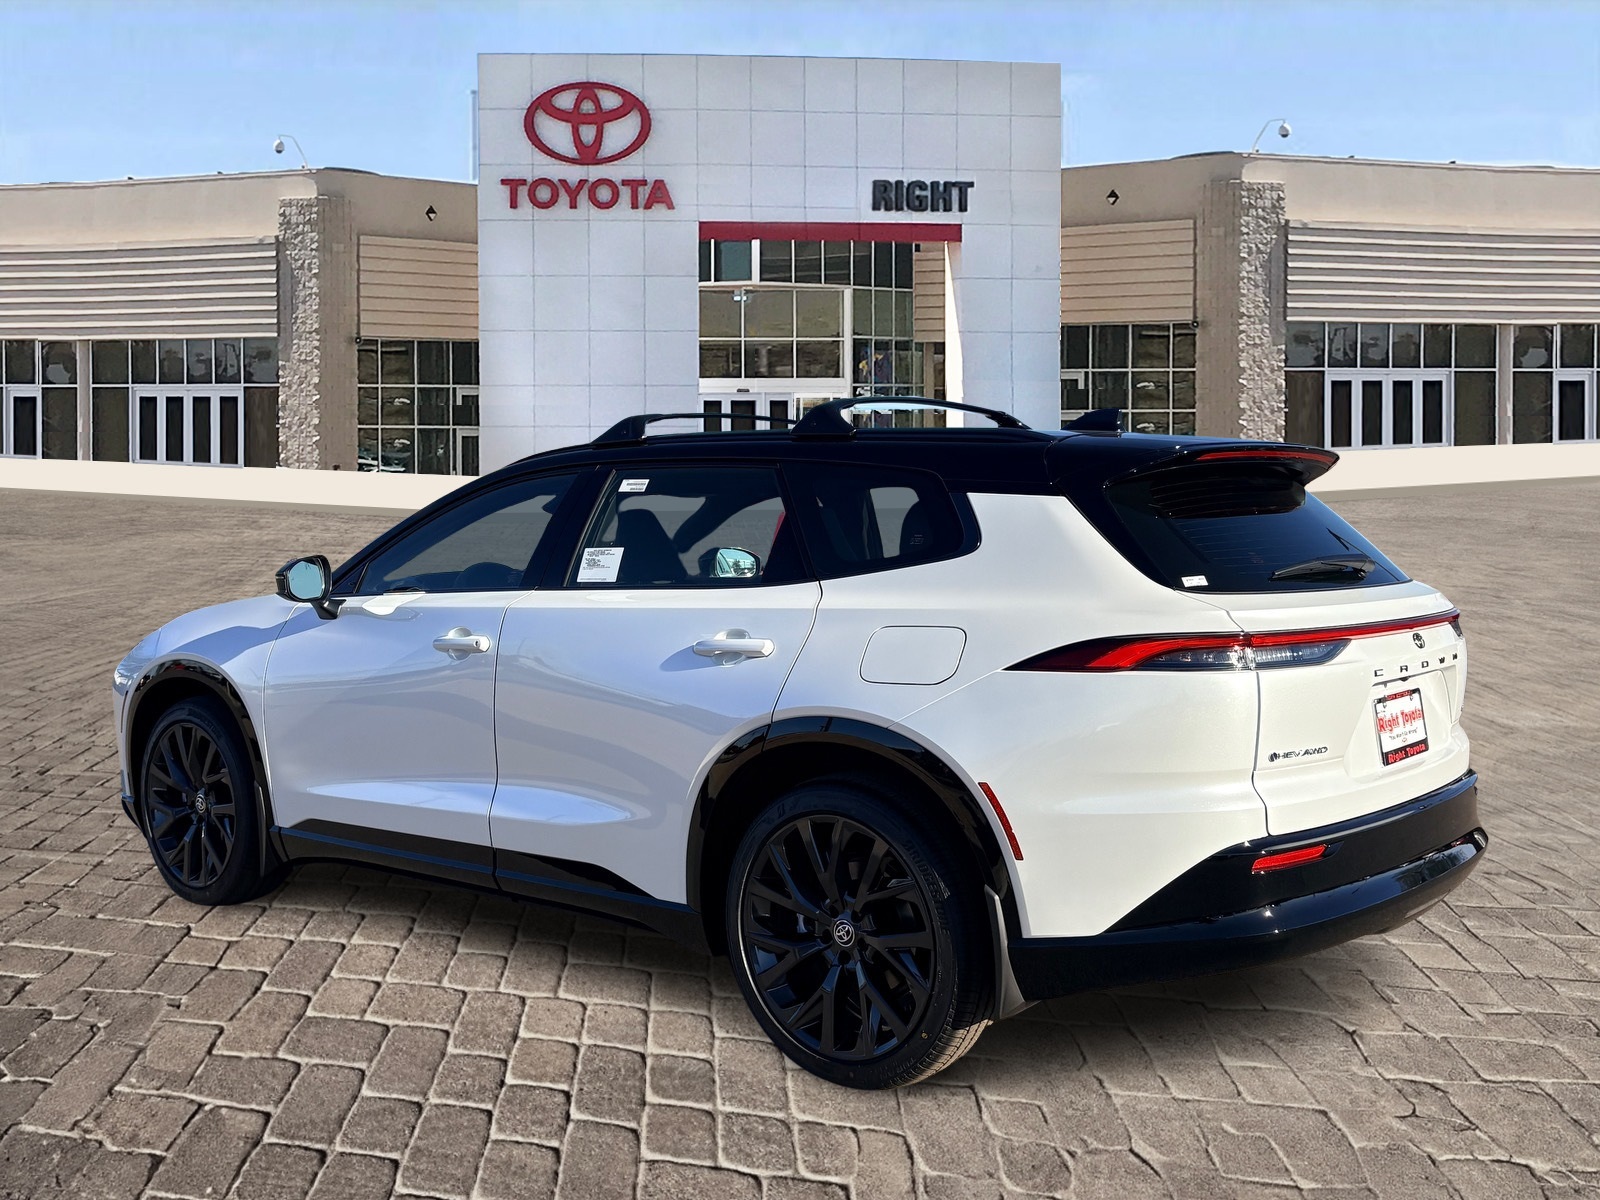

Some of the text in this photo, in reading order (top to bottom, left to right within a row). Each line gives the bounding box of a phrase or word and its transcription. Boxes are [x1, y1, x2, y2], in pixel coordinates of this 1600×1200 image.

[500, 178, 675, 210] TOYOTA
[872, 179, 975, 212] RIGHT
[1374, 653, 1458, 677] CROWN
[1377, 707, 1423, 733] Right Toyota
[1388, 743, 1426, 764] Right Toyota
